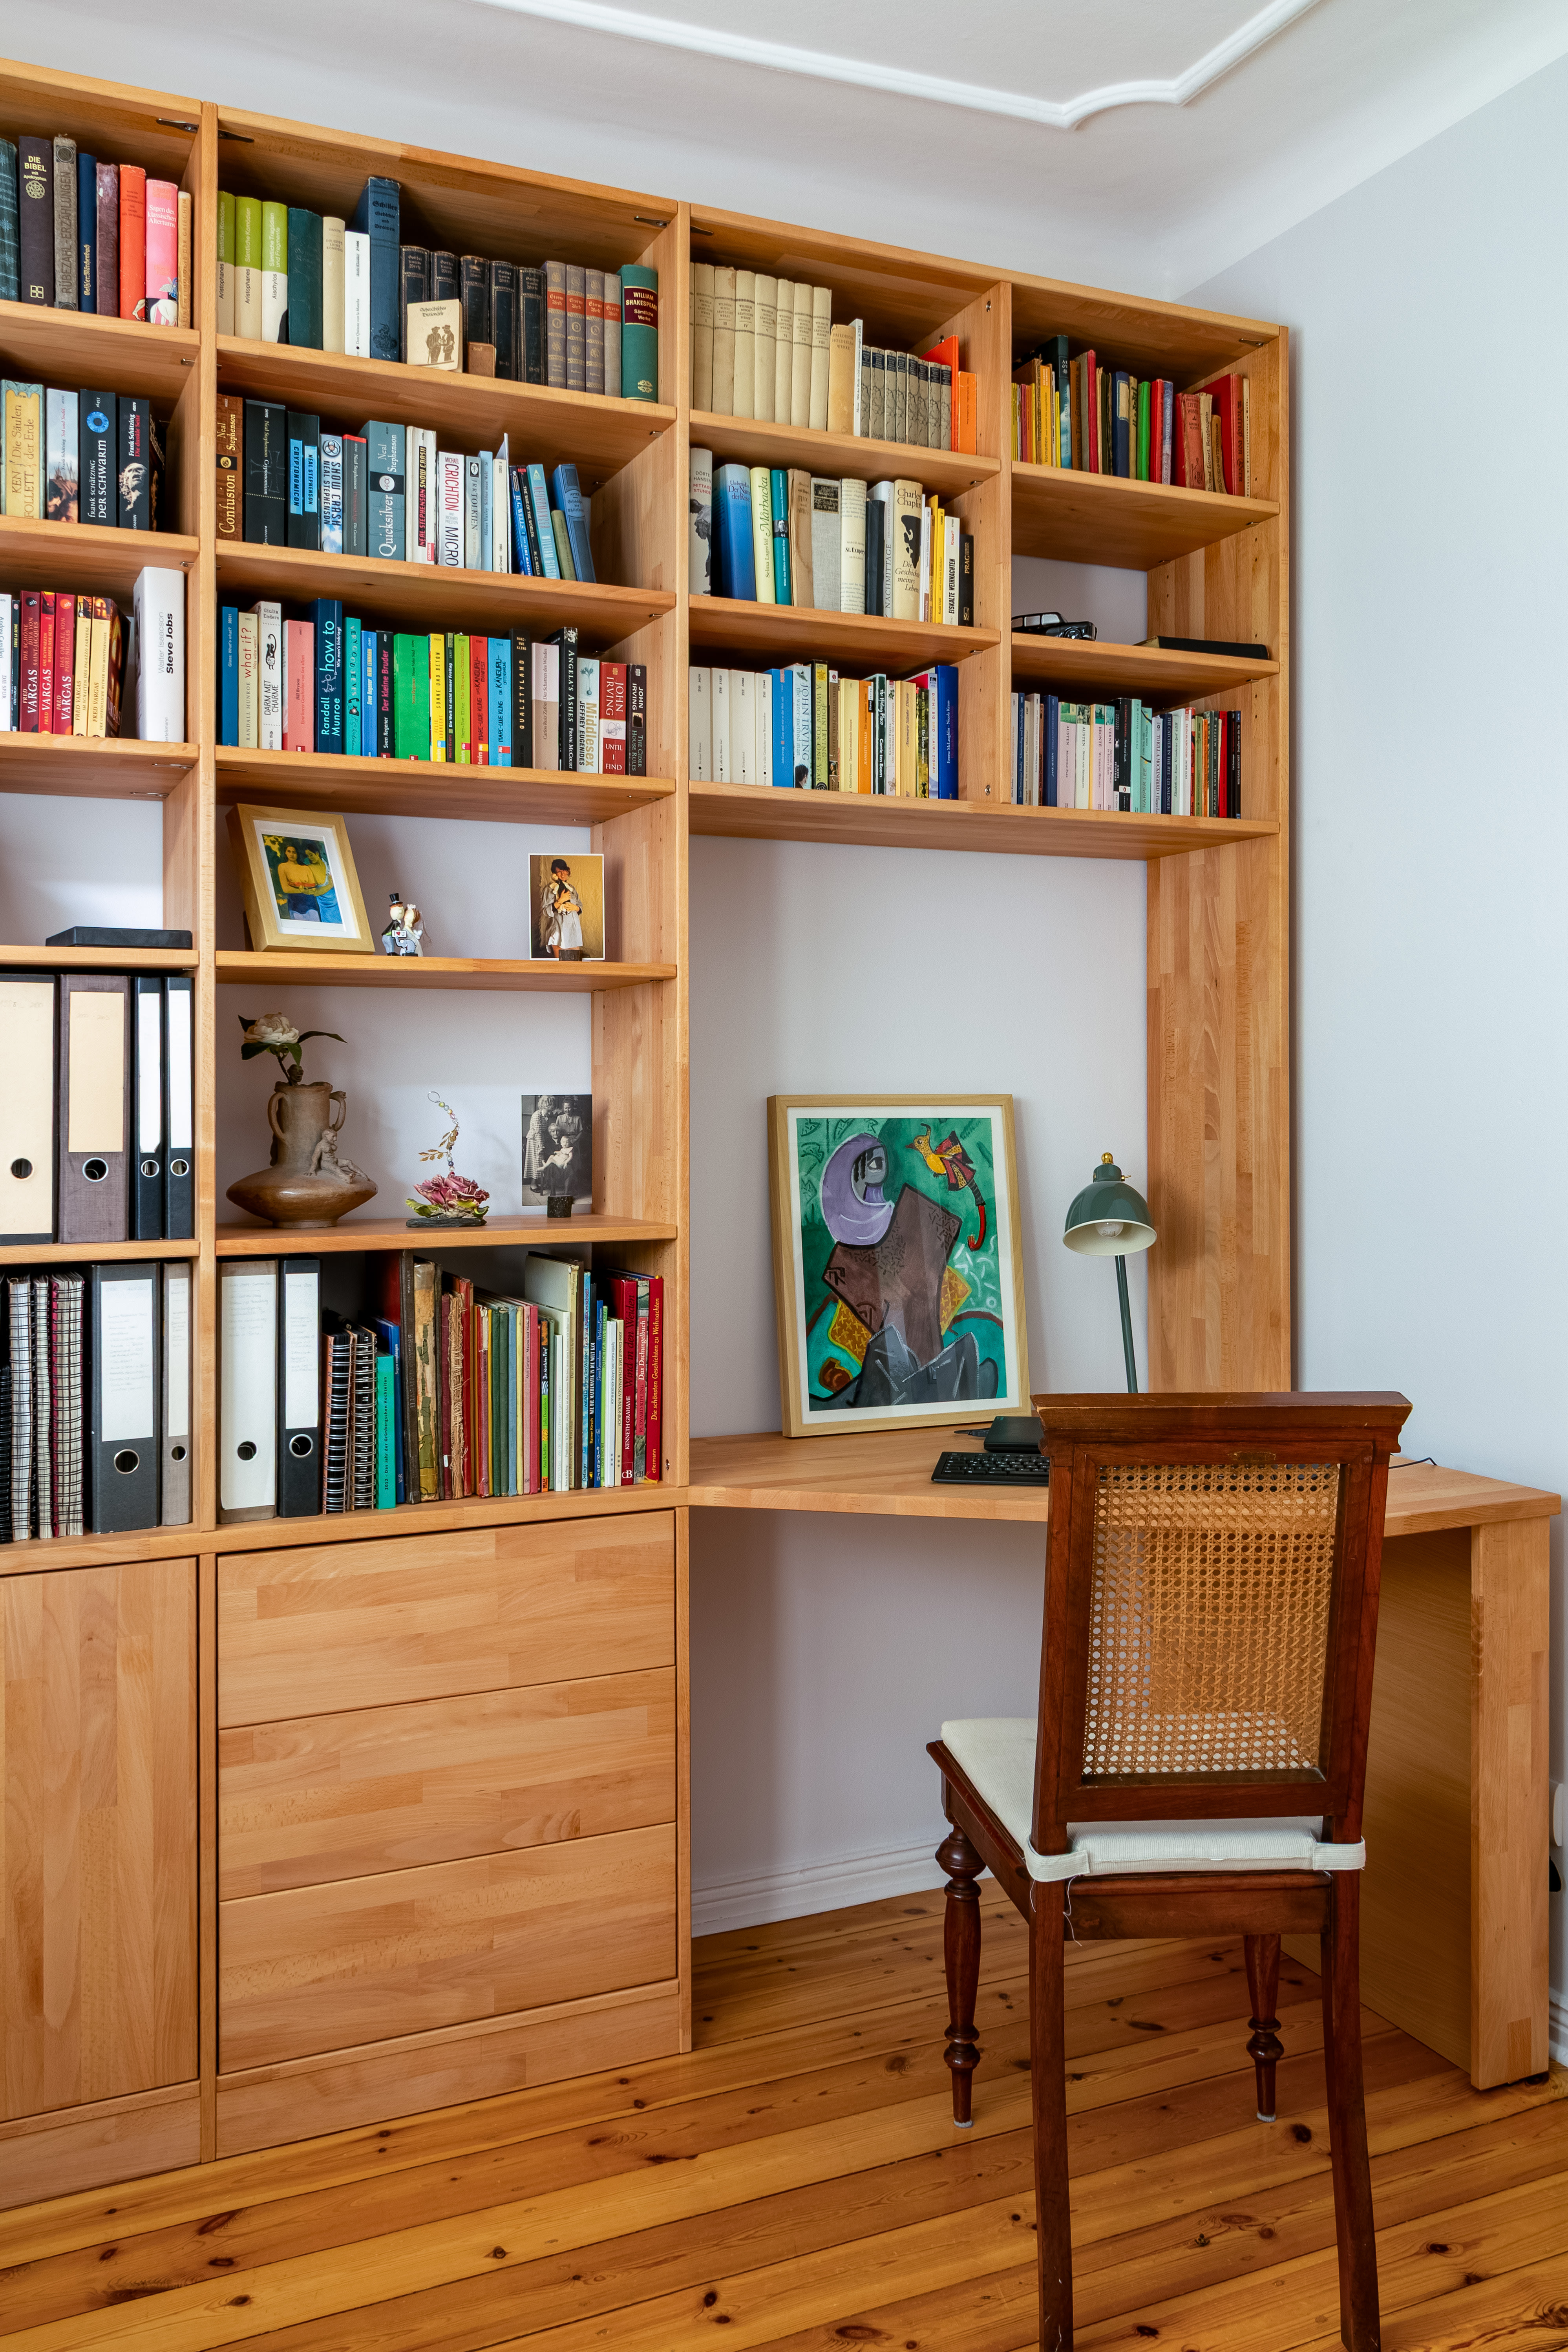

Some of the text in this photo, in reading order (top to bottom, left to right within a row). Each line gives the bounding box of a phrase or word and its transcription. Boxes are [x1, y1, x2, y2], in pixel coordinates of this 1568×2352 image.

[24, 163, 46, 172] BIBEL
[61, 171, 71, 294] RÜBEZAHL-ERZÄHLUNGEN
[148, 211, 176, 222] klassischen
[148, 218, 175, 228] Altertums
[633, 292, 654, 301] WILLIAM
[12, 405, 22, 459] Die Säulen
[24, 419, 34, 460] der Erde
[217, 423, 226, 438] Neal
[227, 415, 236, 450] Stephenson
[378, 444, 387, 460] Neal
[387, 435, 397, 473] Stephenson
[12, 470, 21, 493] KEN
[24, 473, 34, 518] FOLLETT
[331, 462, 341, 526] SNOW CRASH
[445, 464, 459, 511] CRICHTON
[897, 489, 921, 500] Charles
[219, 475, 236, 533] Confusion
[534, 486, 550, 529] NEUROMANCER
[760, 477, 771, 537] Mårbacka
[897, 497, 921, 509] Chaplin
[379, 495, 397, 557] Quicksilver
[445, 527, 459, 566] MICRO
[241, 627, 252, 645] if?
[319, 620, 334, 672] how to
[241, 649, 252, 678] what
[27, 669, 38, 713] VARGAS
[42, 669, 51, 710] VARGAS
[61, 676, 71, 720] VARGAS
[606, 676, 614, 716] IRVING
[614, 682, 624, 712] JOHN
[800, 683, 809, 715] JOHN
[321, 697, 329, 735] Randall
[331, 698, 340, 736] Munroe
[586, 702, 597, 767] Middlesex
[654, 1336, 659, 1344] zu
